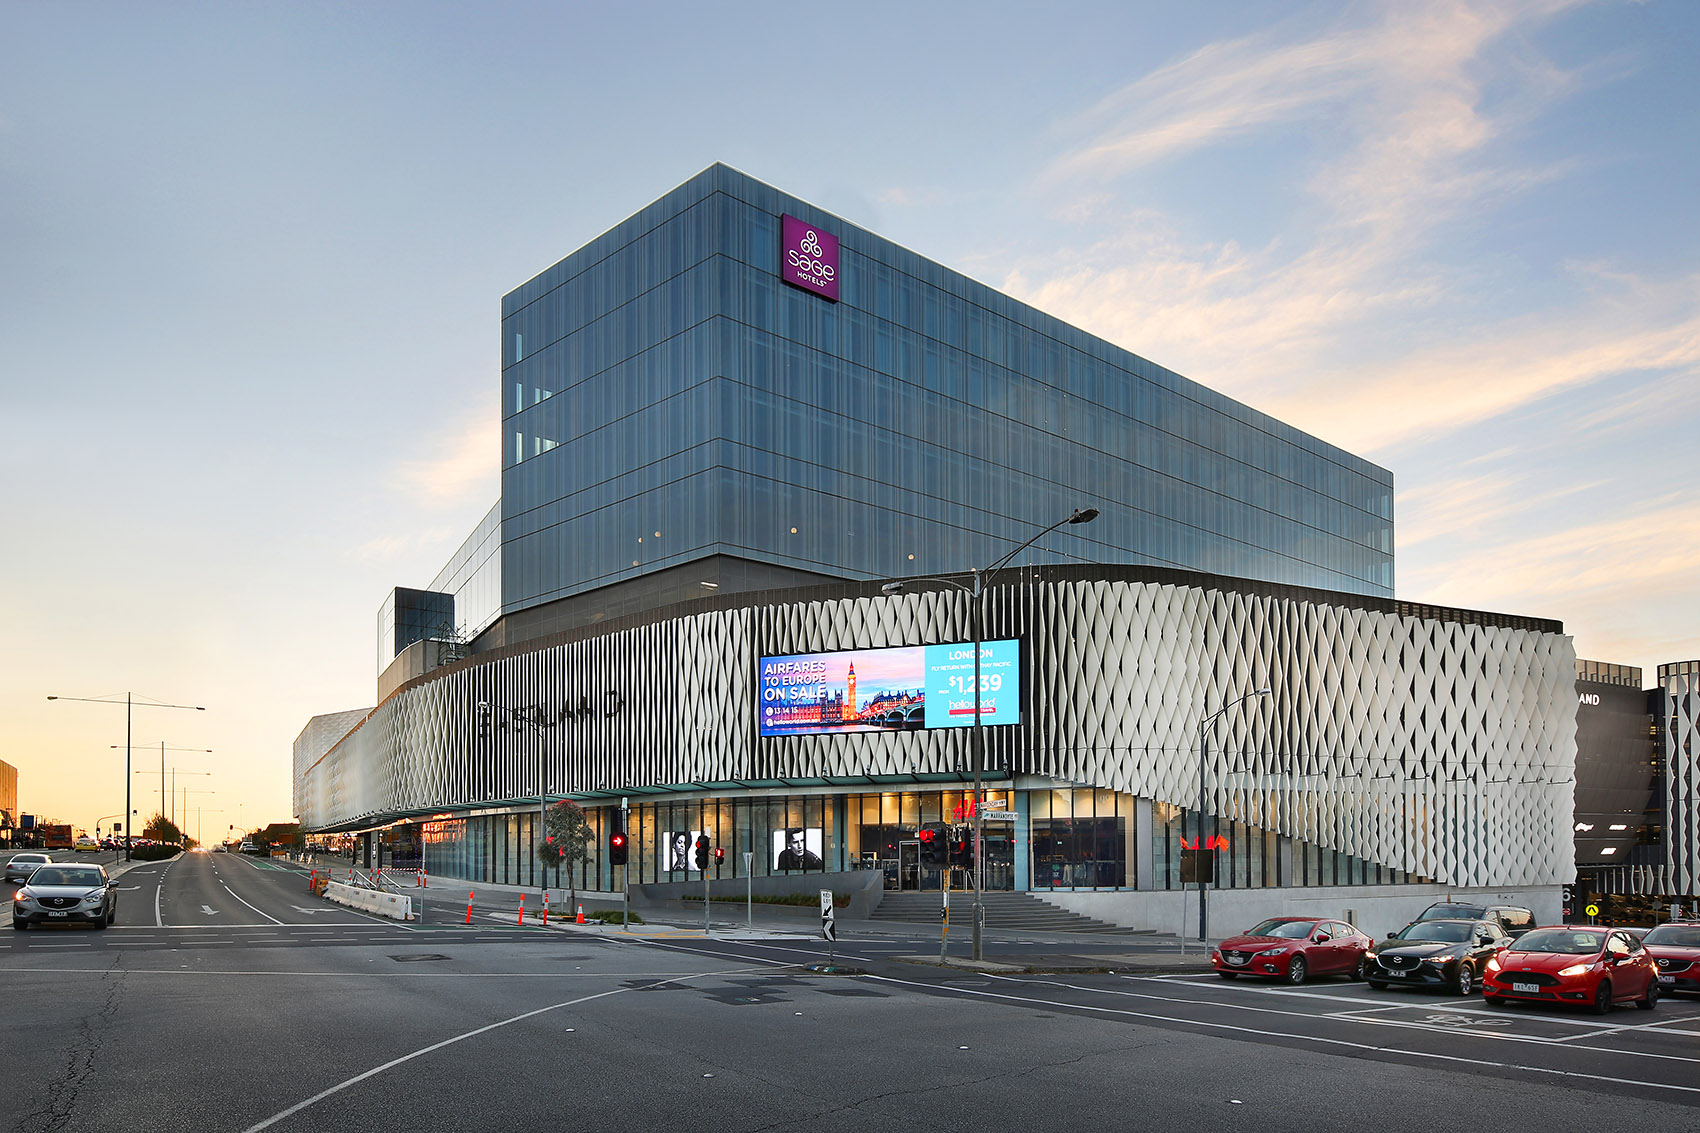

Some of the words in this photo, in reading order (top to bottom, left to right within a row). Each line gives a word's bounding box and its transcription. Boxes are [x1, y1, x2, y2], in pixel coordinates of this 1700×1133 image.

[949, 649, 993, 660] LONDON
[764, 661, 826, 675] AIRFARES
[764, 676, 779, 687] TO
[782, 674, 826, 686] EUROPE
[764, 687, 786, 702] ON
[790, 685, 826, 700] SALE
